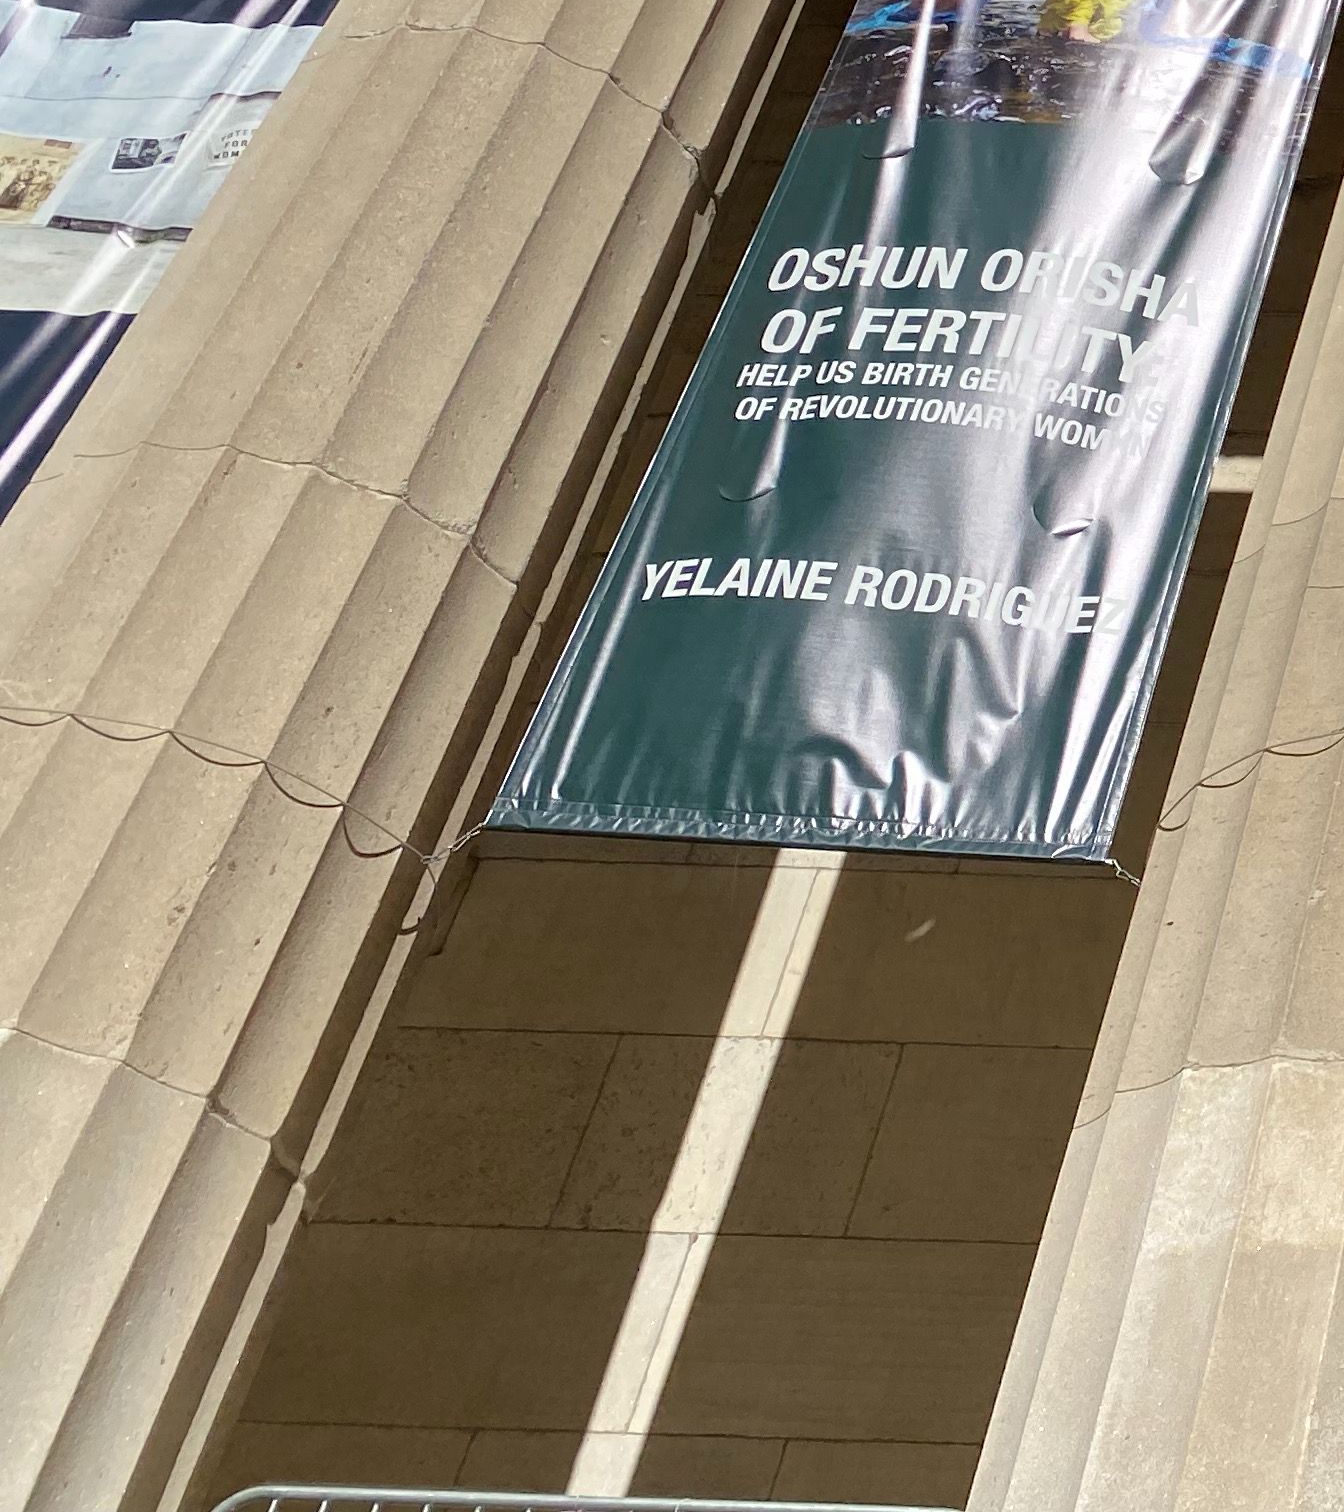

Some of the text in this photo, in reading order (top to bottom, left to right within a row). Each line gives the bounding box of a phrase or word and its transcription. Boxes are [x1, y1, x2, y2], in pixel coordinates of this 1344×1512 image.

[767, 244, 1200, 327] OSHUN ORISHA
[760, 307, 842, 355] OF
[734, 396, 778, 421] OF
[779, 394, 1026, 432] REVOLUTIONARY
[736, 360, 1165, 423] HELP US BIRTH GENRATIONS
[641, 558, 1130, 634] YELAINE RODRIGUEZ
